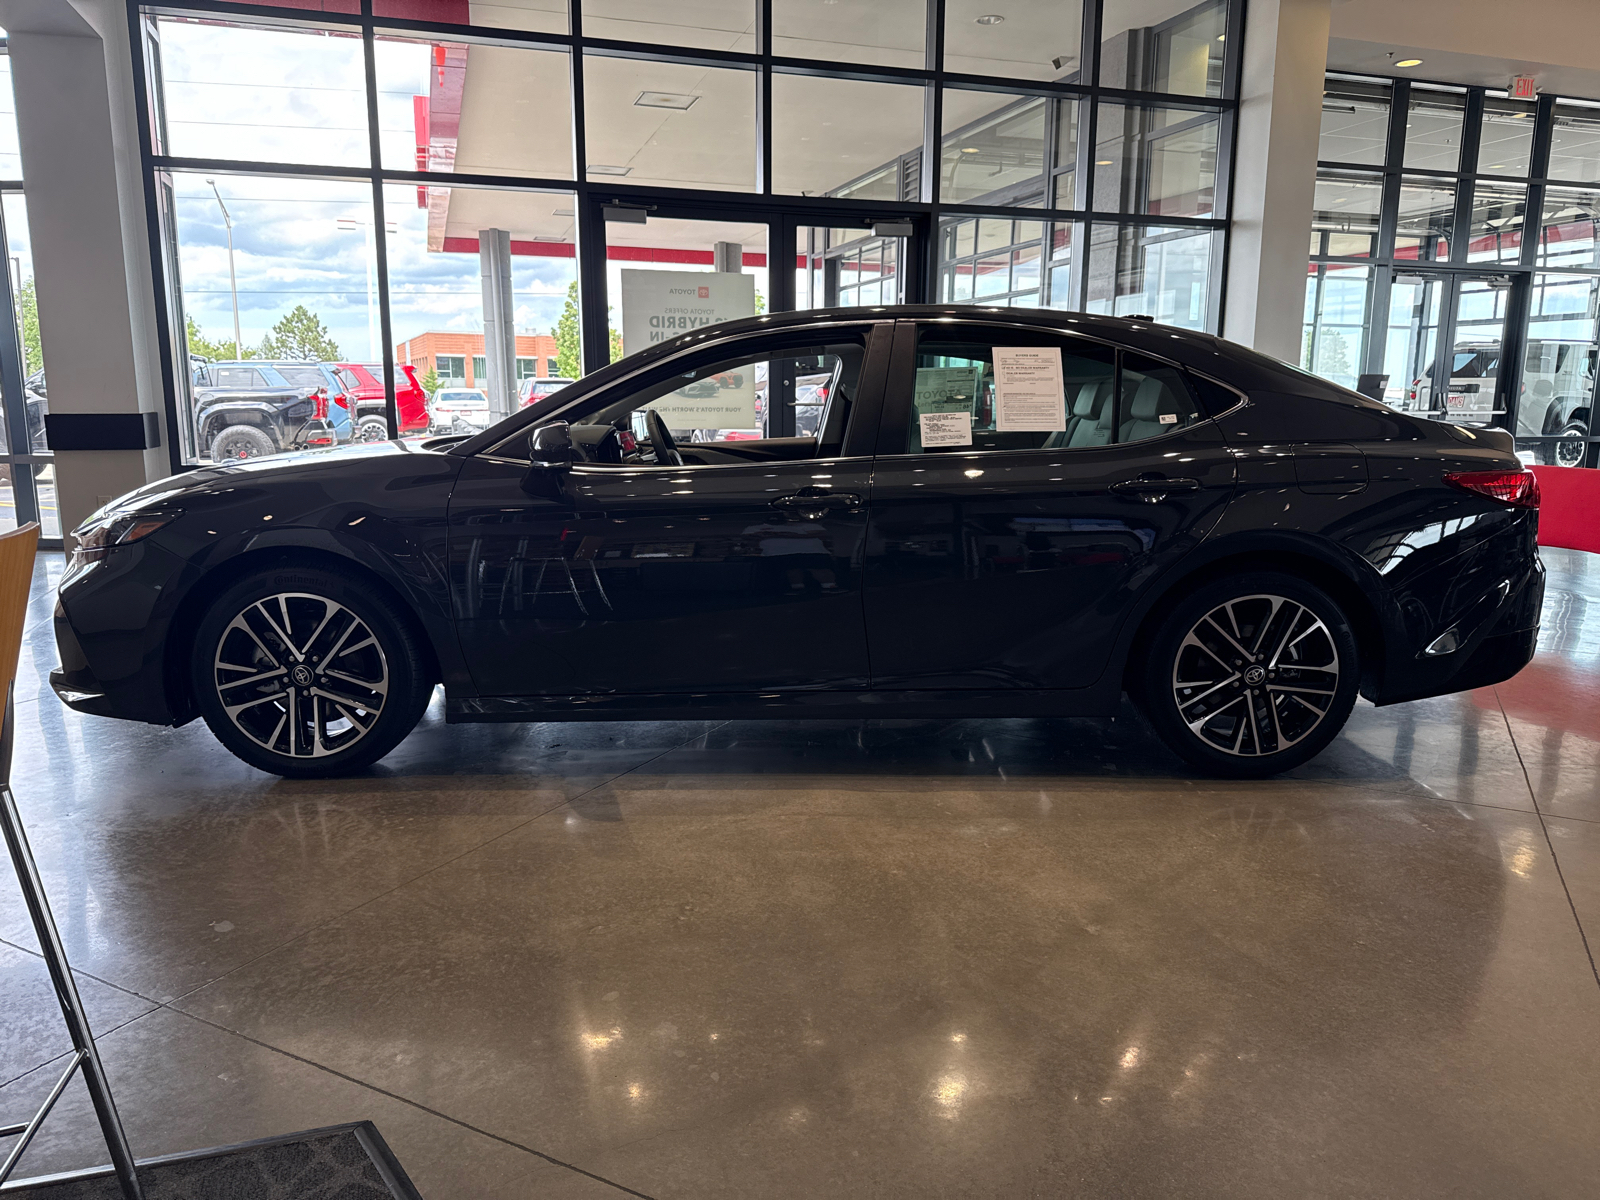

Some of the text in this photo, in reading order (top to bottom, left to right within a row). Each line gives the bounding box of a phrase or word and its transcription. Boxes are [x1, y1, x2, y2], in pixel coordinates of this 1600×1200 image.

[1516, 78, 1535, 97] EXIT
[916, 389, 961, 400] TOYOTA
[274, 574, 328, 588] Continental
